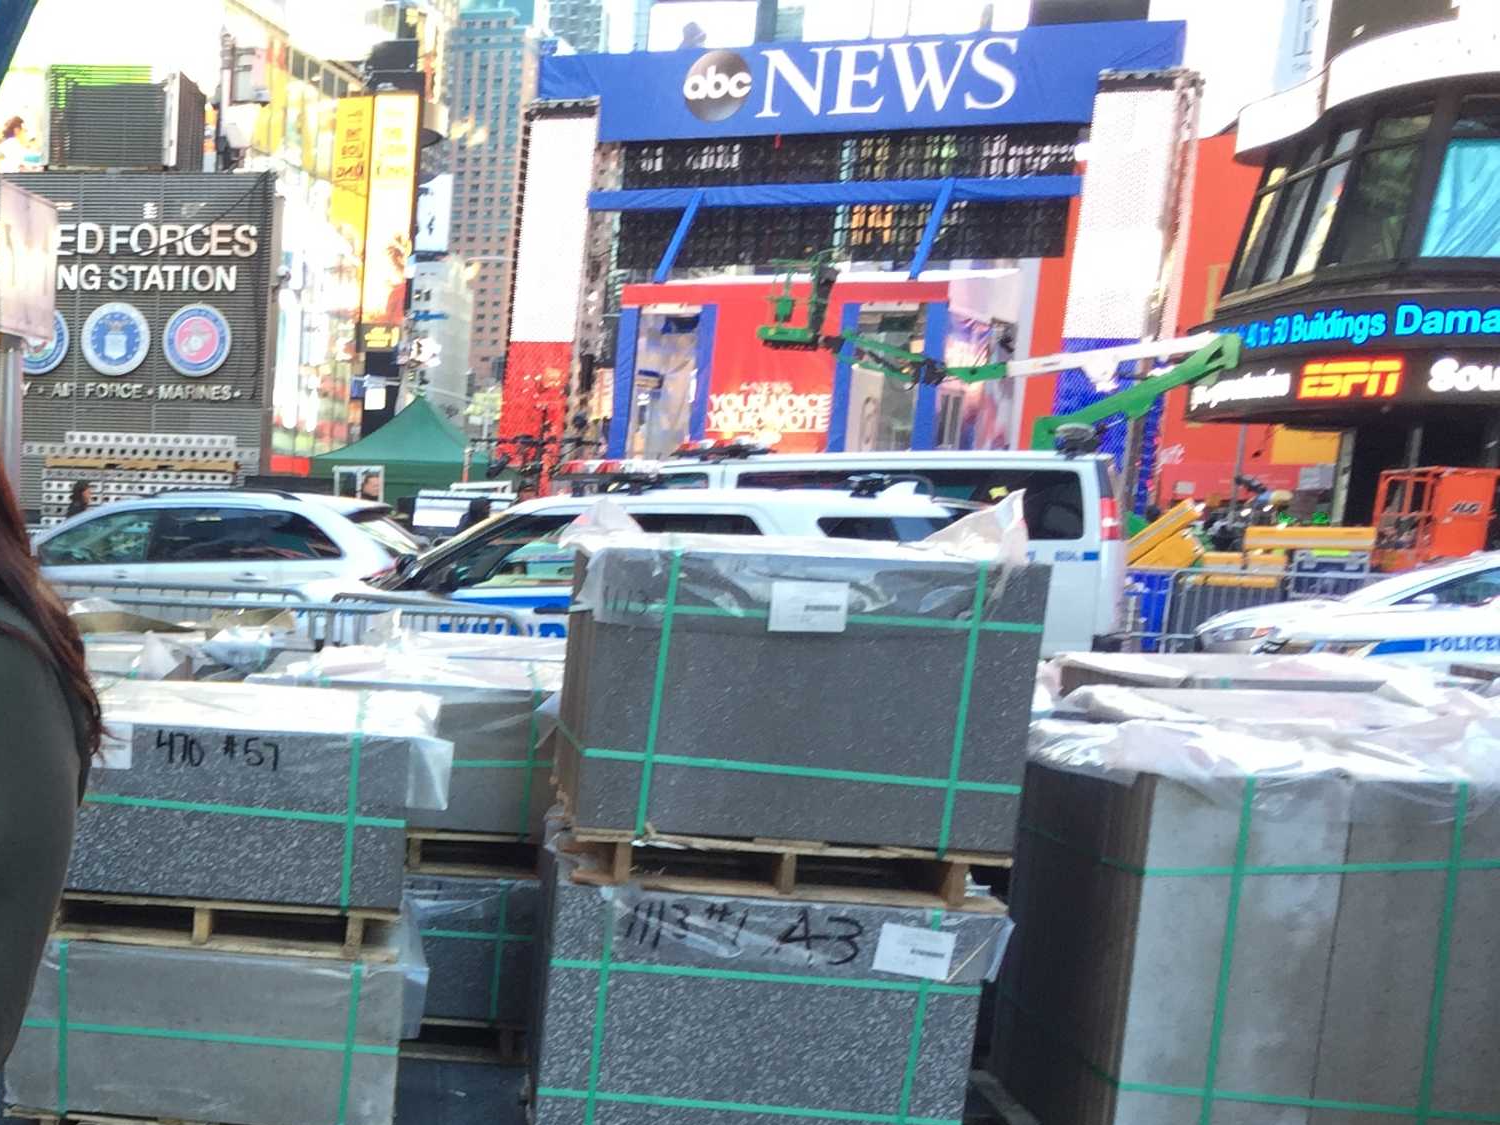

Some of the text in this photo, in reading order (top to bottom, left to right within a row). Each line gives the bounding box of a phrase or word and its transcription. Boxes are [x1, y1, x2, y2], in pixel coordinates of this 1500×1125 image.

[682, 37, 1019, 118] abc NEWS
[110, 222, 258, 257] FORCES
[108, 264, 237, 292] STATION
[1290, 309, 1387, 344] Buildings
[52, 382, 77, 397] AIR
[85, 382, 143, 399] FORCE
[158, 383, 231, 401] MARINES
[1298, 358, 1404, 399] ESPN
